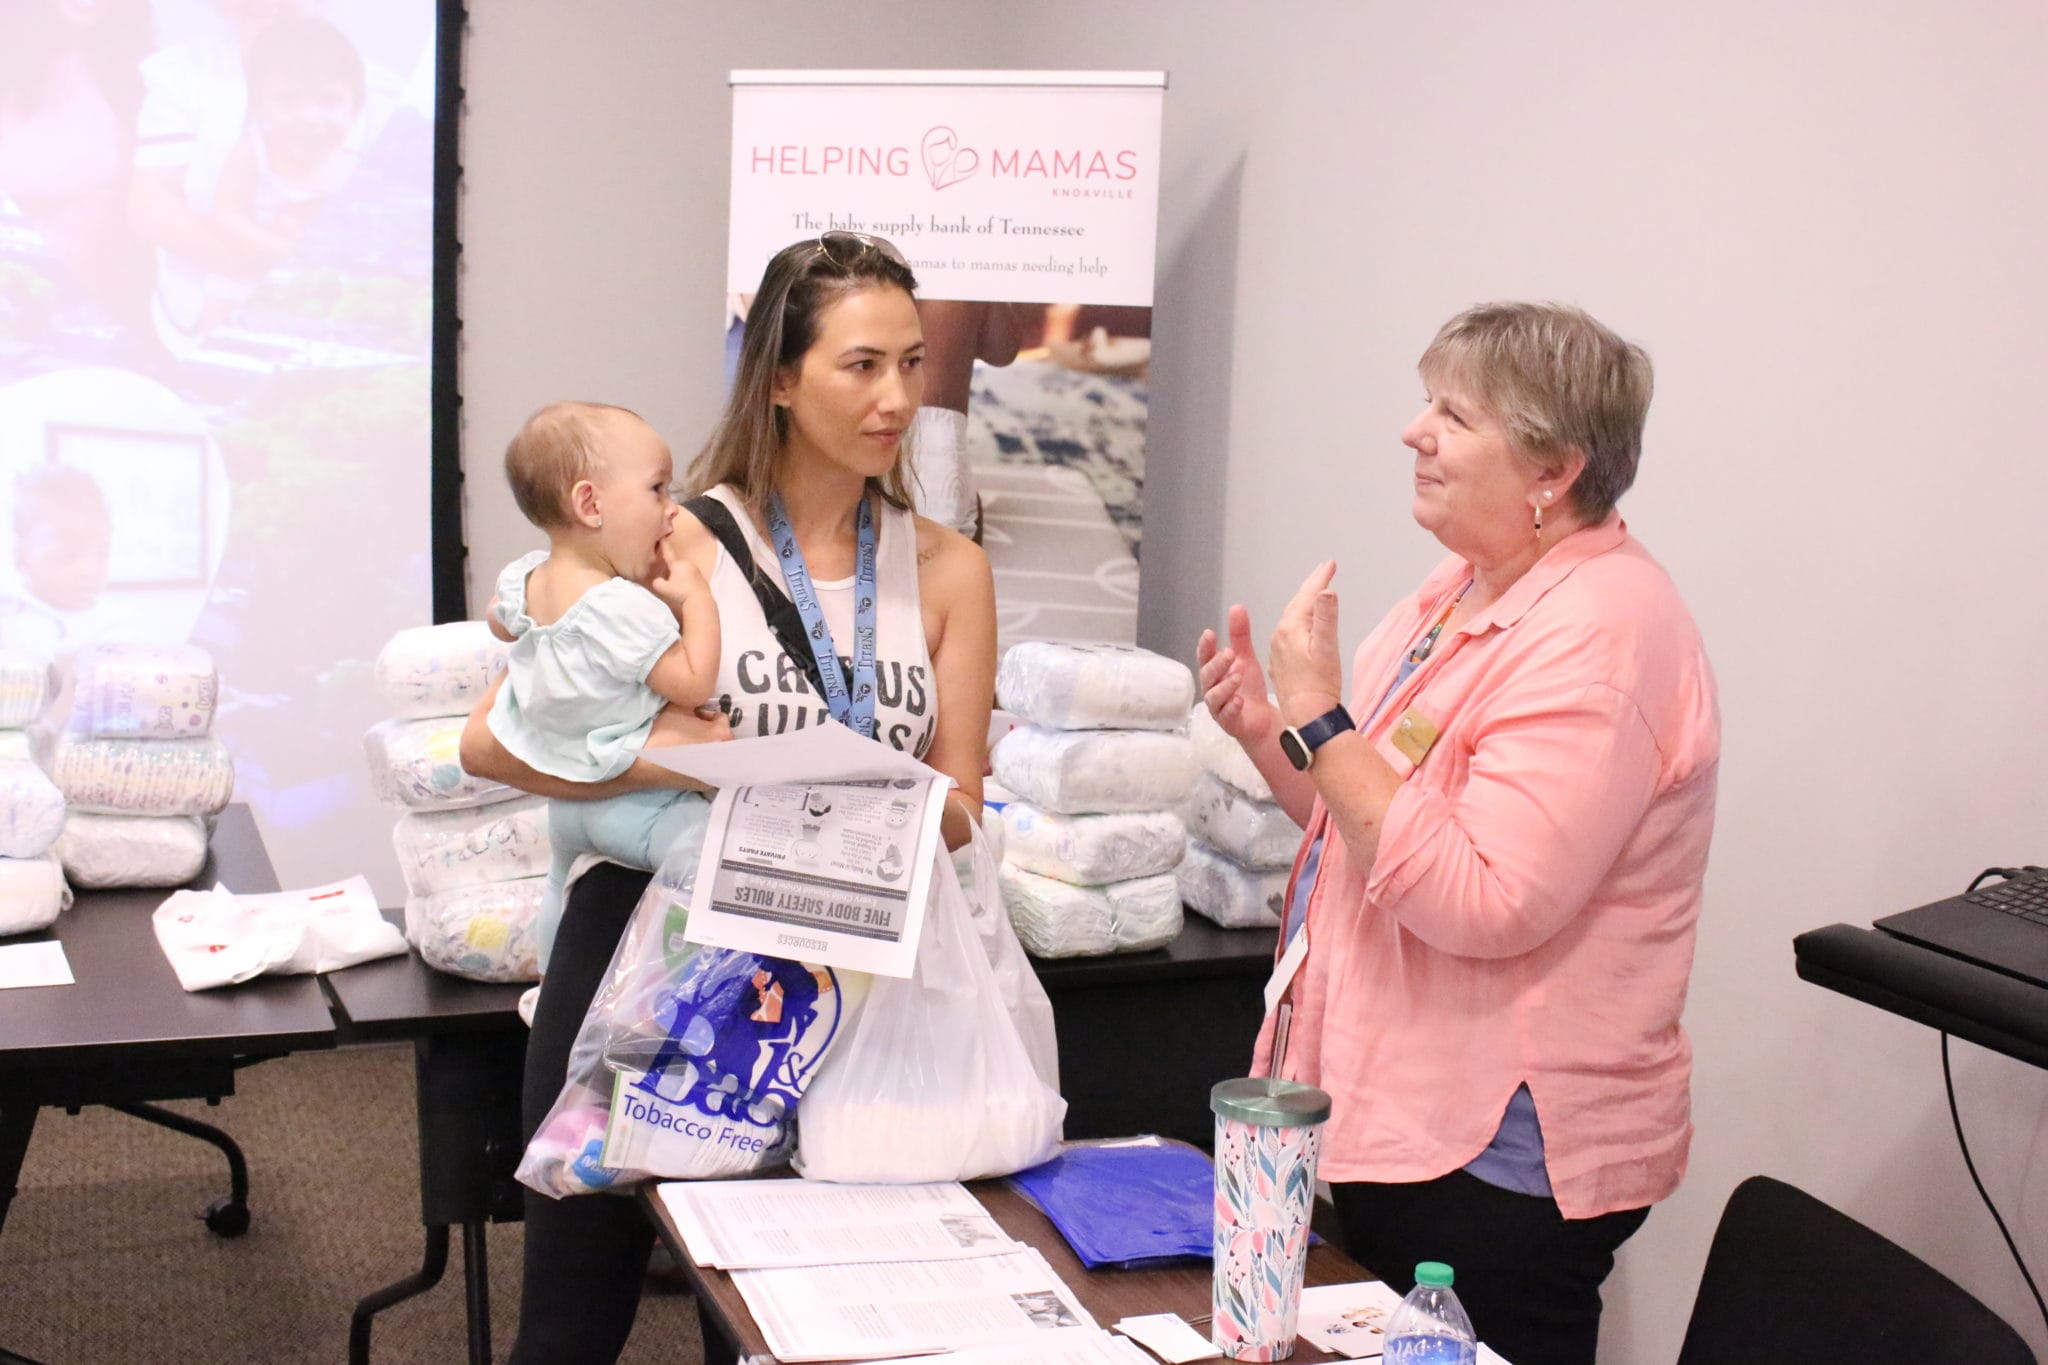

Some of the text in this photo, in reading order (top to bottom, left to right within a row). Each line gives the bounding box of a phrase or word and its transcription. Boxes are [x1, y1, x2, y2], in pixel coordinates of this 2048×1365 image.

[751, 145, 1138, 181] HELPING MAMAS
[1052, 188, 1134, 199] KNOXVILLE
[792, 211, 1085, 236] The baby supply bank of Tennessee
[951, 258, 966, 270] to
[970, 260, 1018, 272] mamas
[1022, 255, 1075, 275] needing
[1079, 256, 1108, 277] help
[786, 565, 817, 612] TITANS
[737, 650, 926, 717] CAUS
[817, 648, 846, 699] TITANS
[739, 846, 786, 860] PRIVATE PARTS
[735, 886, 892, 927] FIVE BODY SAFETY RULES
[777, 934, 829, 951] RESOURCES
[624, 1094, 764, 1153] Tobacco Free
